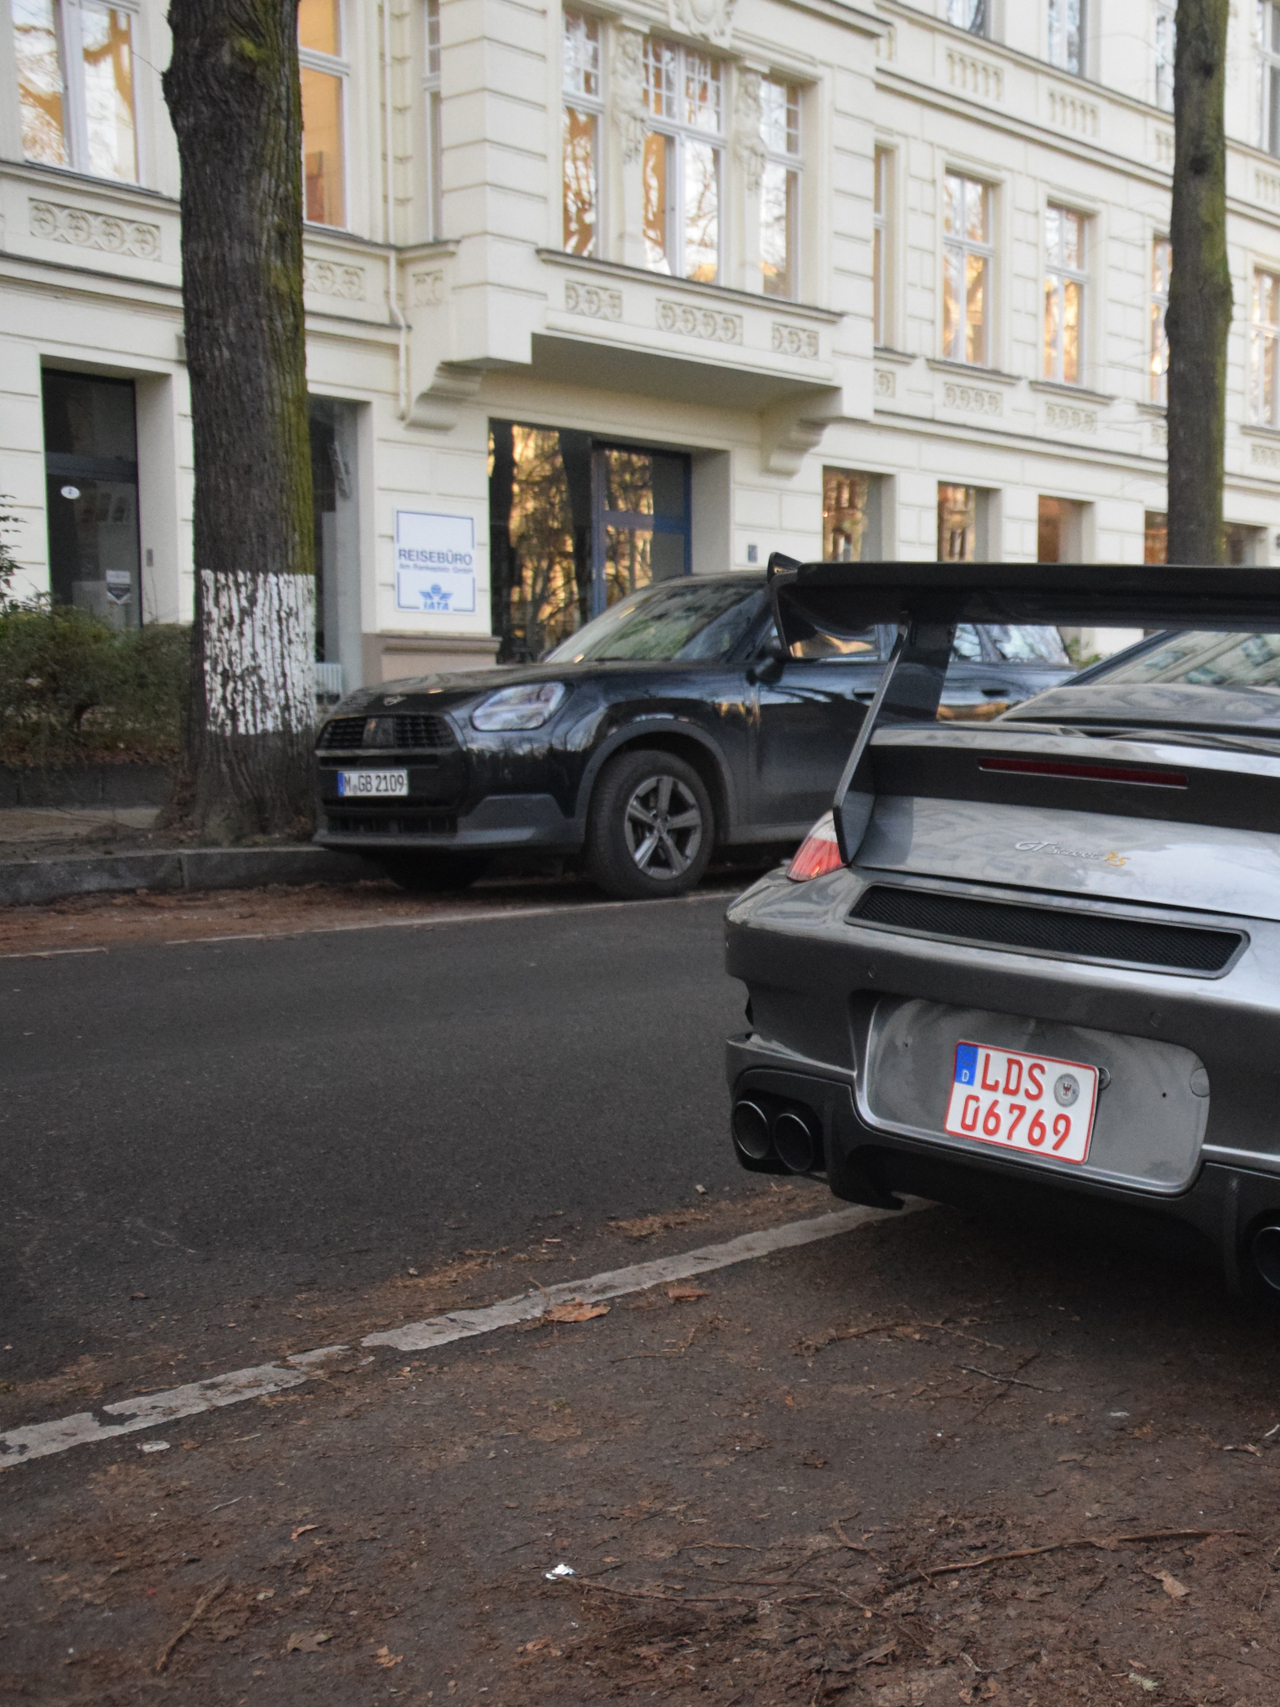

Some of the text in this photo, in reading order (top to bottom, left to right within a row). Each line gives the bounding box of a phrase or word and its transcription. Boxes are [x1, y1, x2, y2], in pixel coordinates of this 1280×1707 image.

[398, 548, 473, 566] REISEBÜRO
[424, 601, 449, 611] IATA
[343, 774, 405, 793] M GB 2109
[1103, 851, 1132, 867] RS
[961, 1069, 970, 1082] D
[981, 1053, 1046, 1102] LDS
[960, 1094, 1072, 1151] 06769
